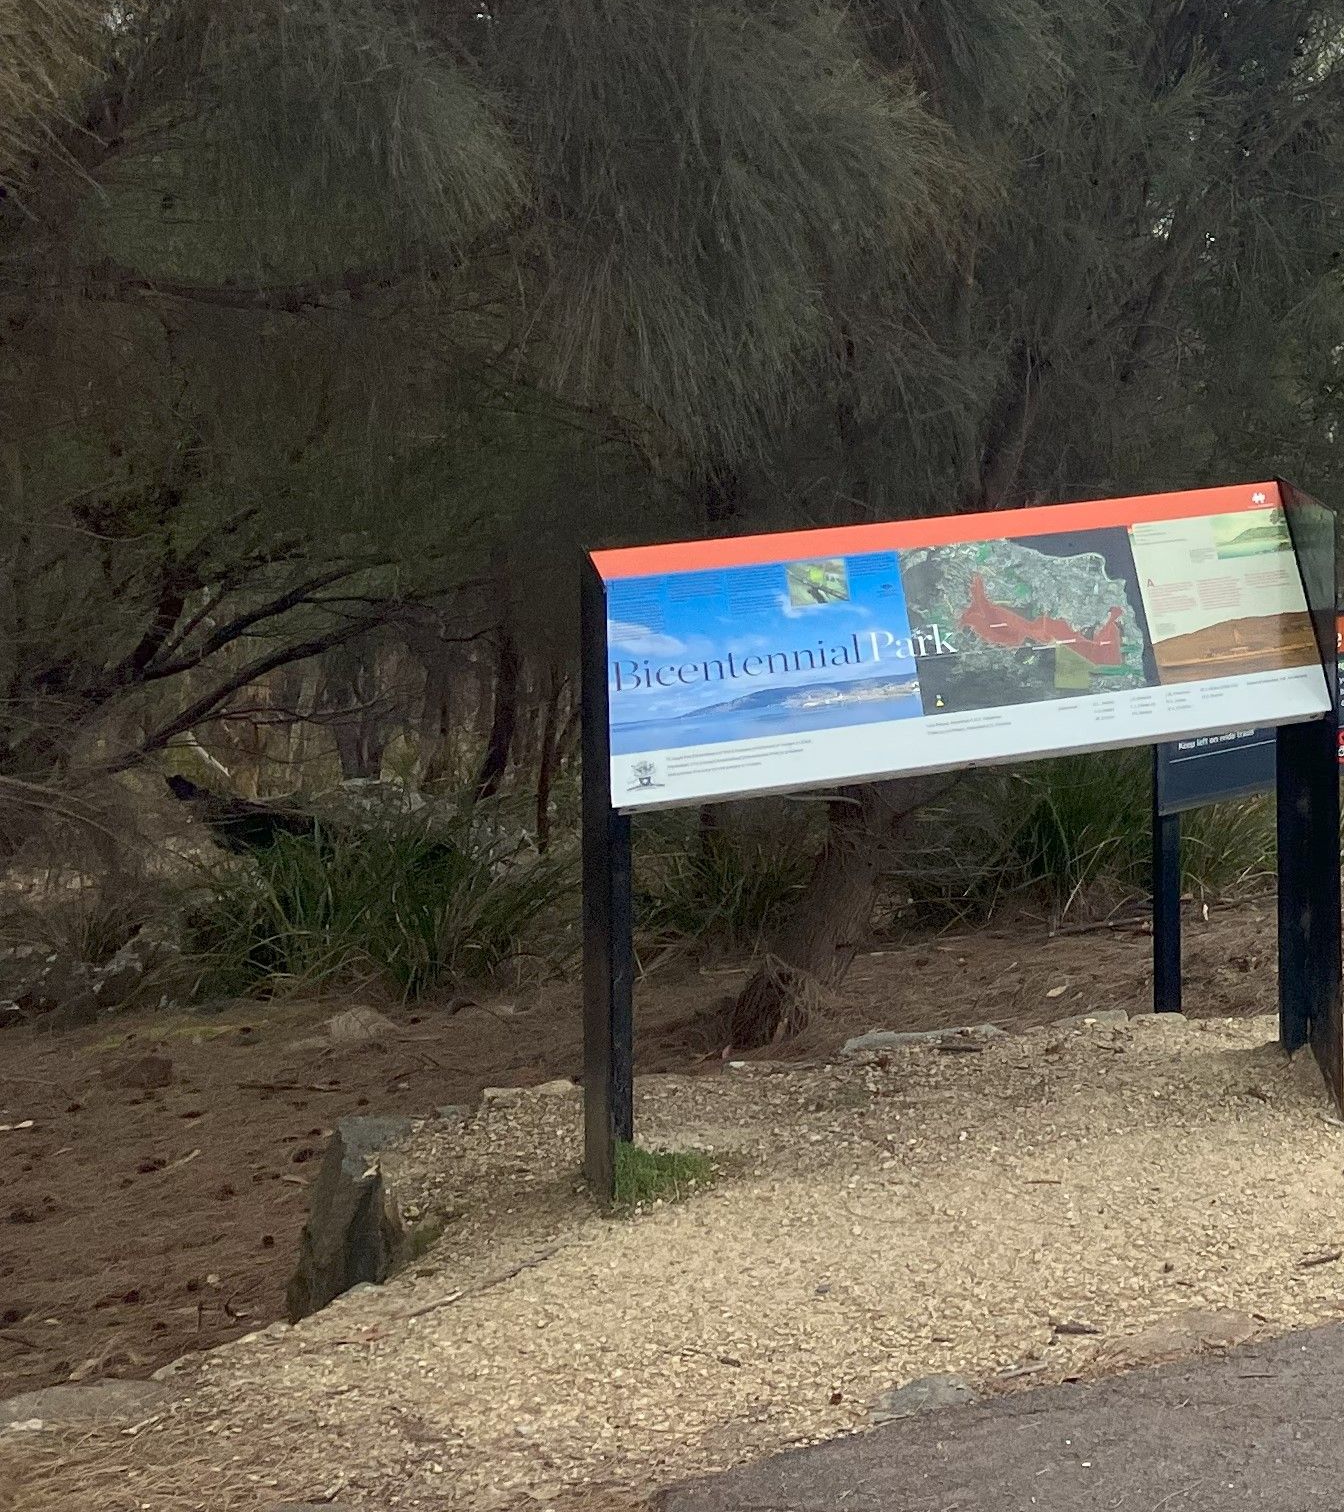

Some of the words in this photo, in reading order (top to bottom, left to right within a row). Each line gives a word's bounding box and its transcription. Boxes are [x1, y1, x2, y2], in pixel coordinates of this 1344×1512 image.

[613, 633, 863, 692] Bicentennial
[869, 623, 958, 662] Park
[1178, 741, 1196, 751] Keep
[1196, 737, 1208, 747] left
[1209, 736, 1219, 744] on
